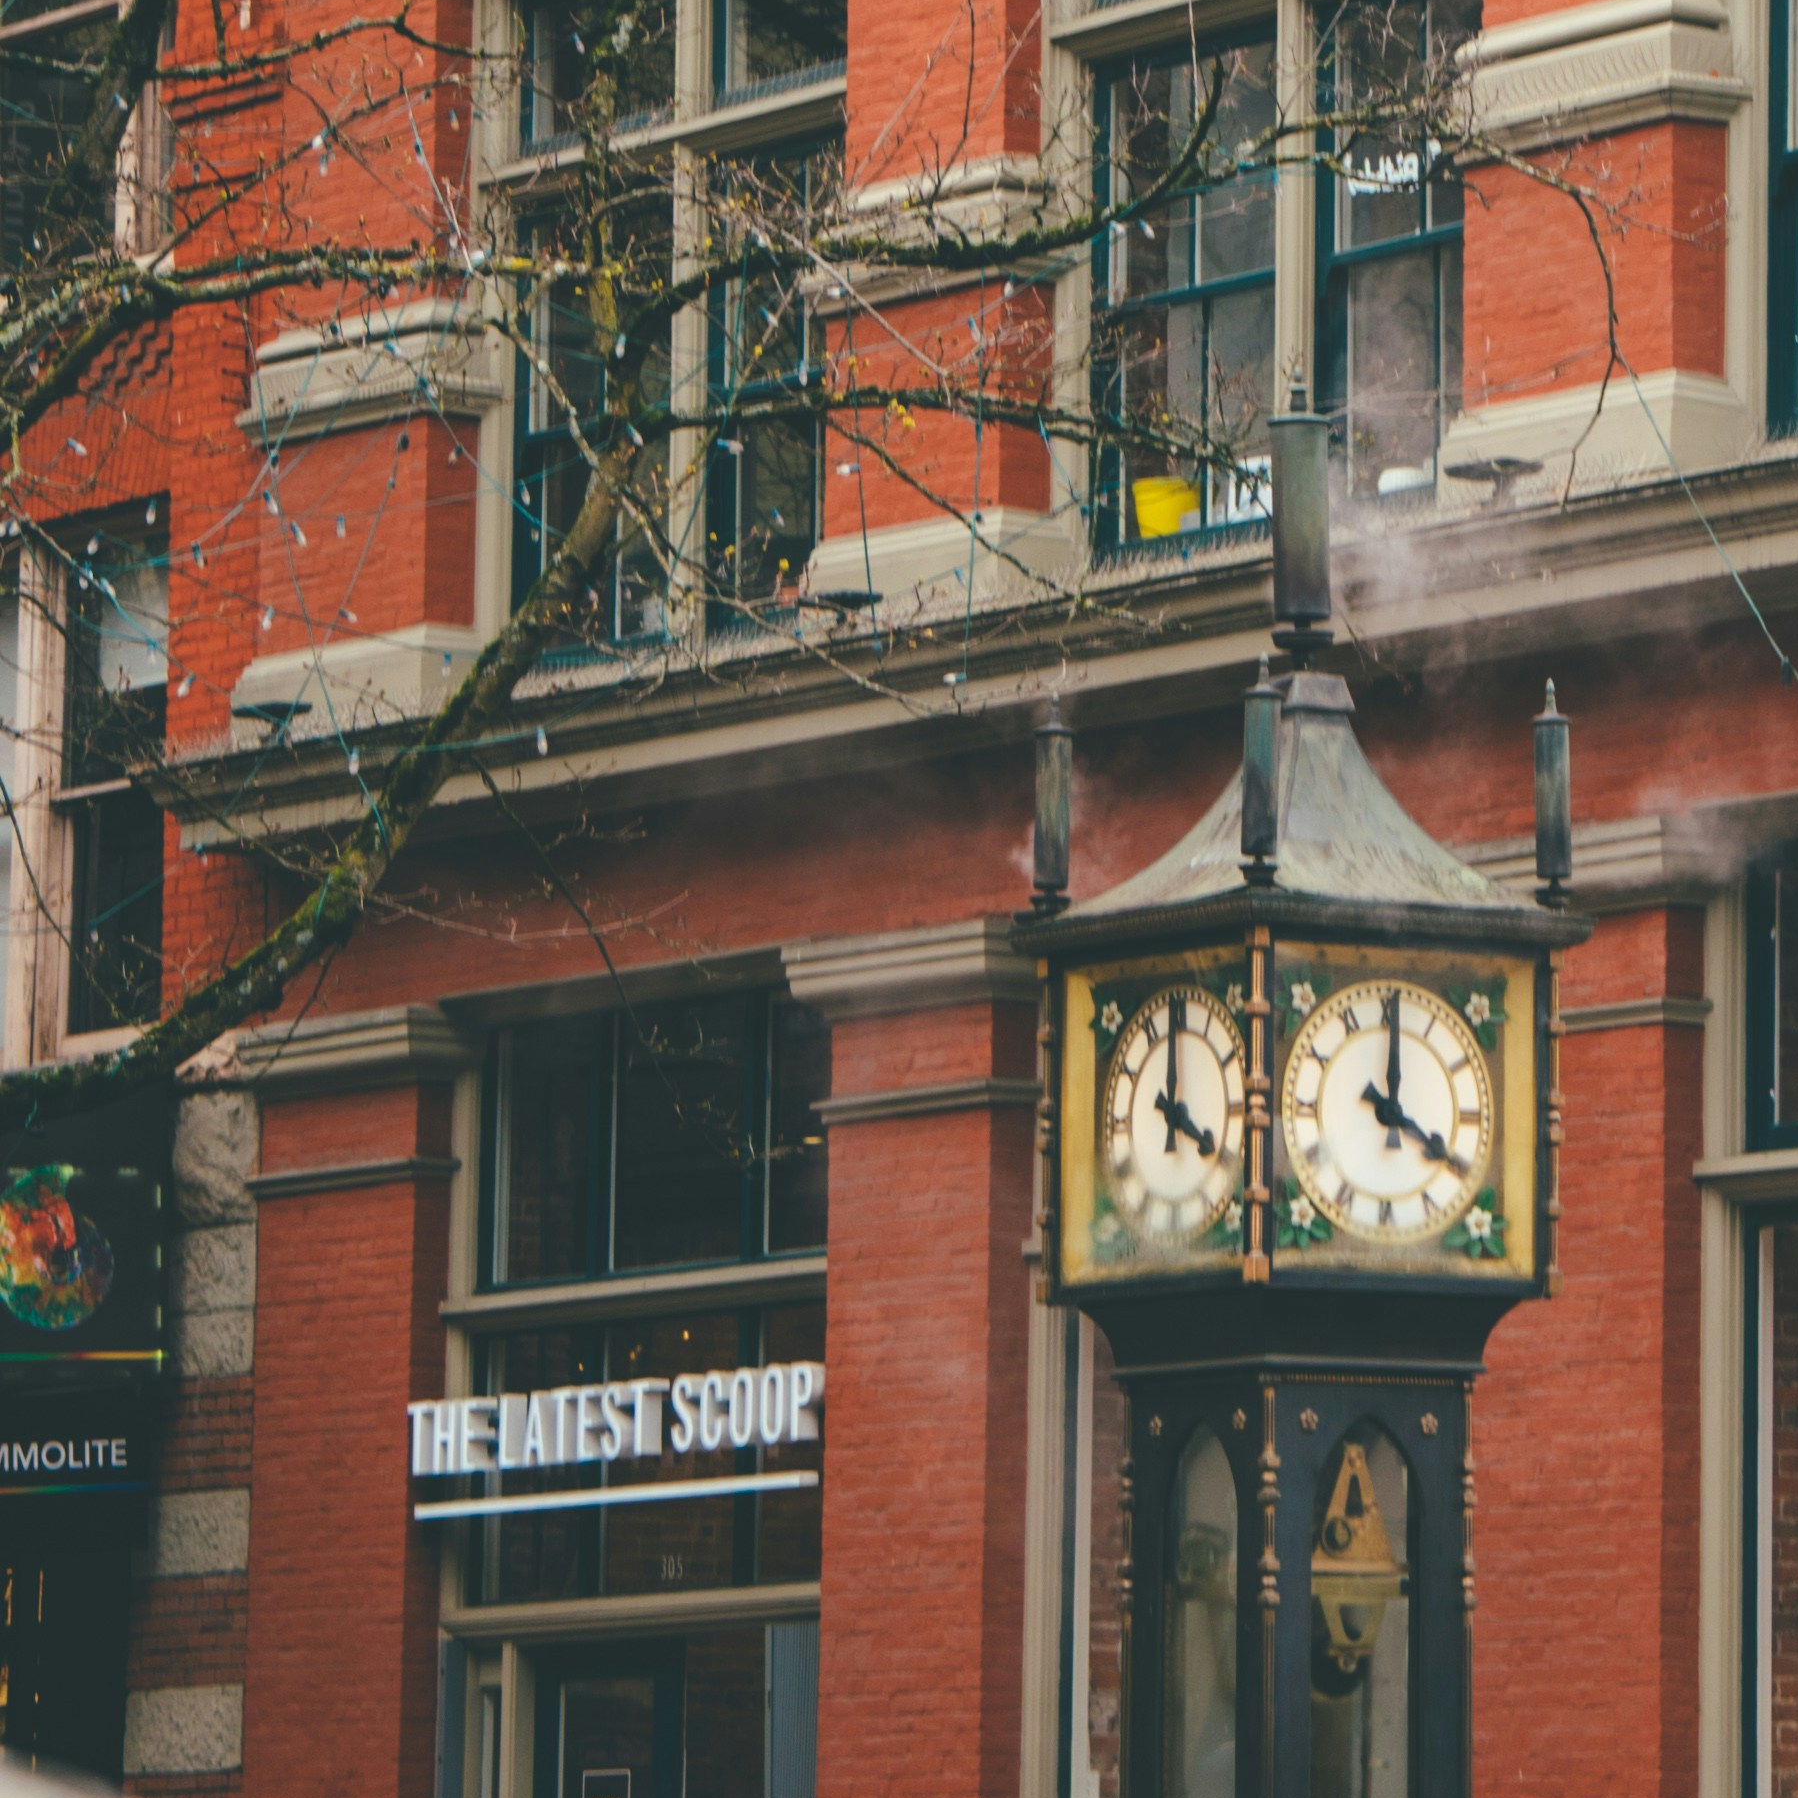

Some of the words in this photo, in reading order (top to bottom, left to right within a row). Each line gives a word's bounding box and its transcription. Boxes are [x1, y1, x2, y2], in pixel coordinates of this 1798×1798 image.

[407, 1397, 497, 1477] THE
[498, 1378, 670, 1470] LATEST
[670, 1361, 825, 1454] SCOOP
[660, 1554, 684, 1581] 305
